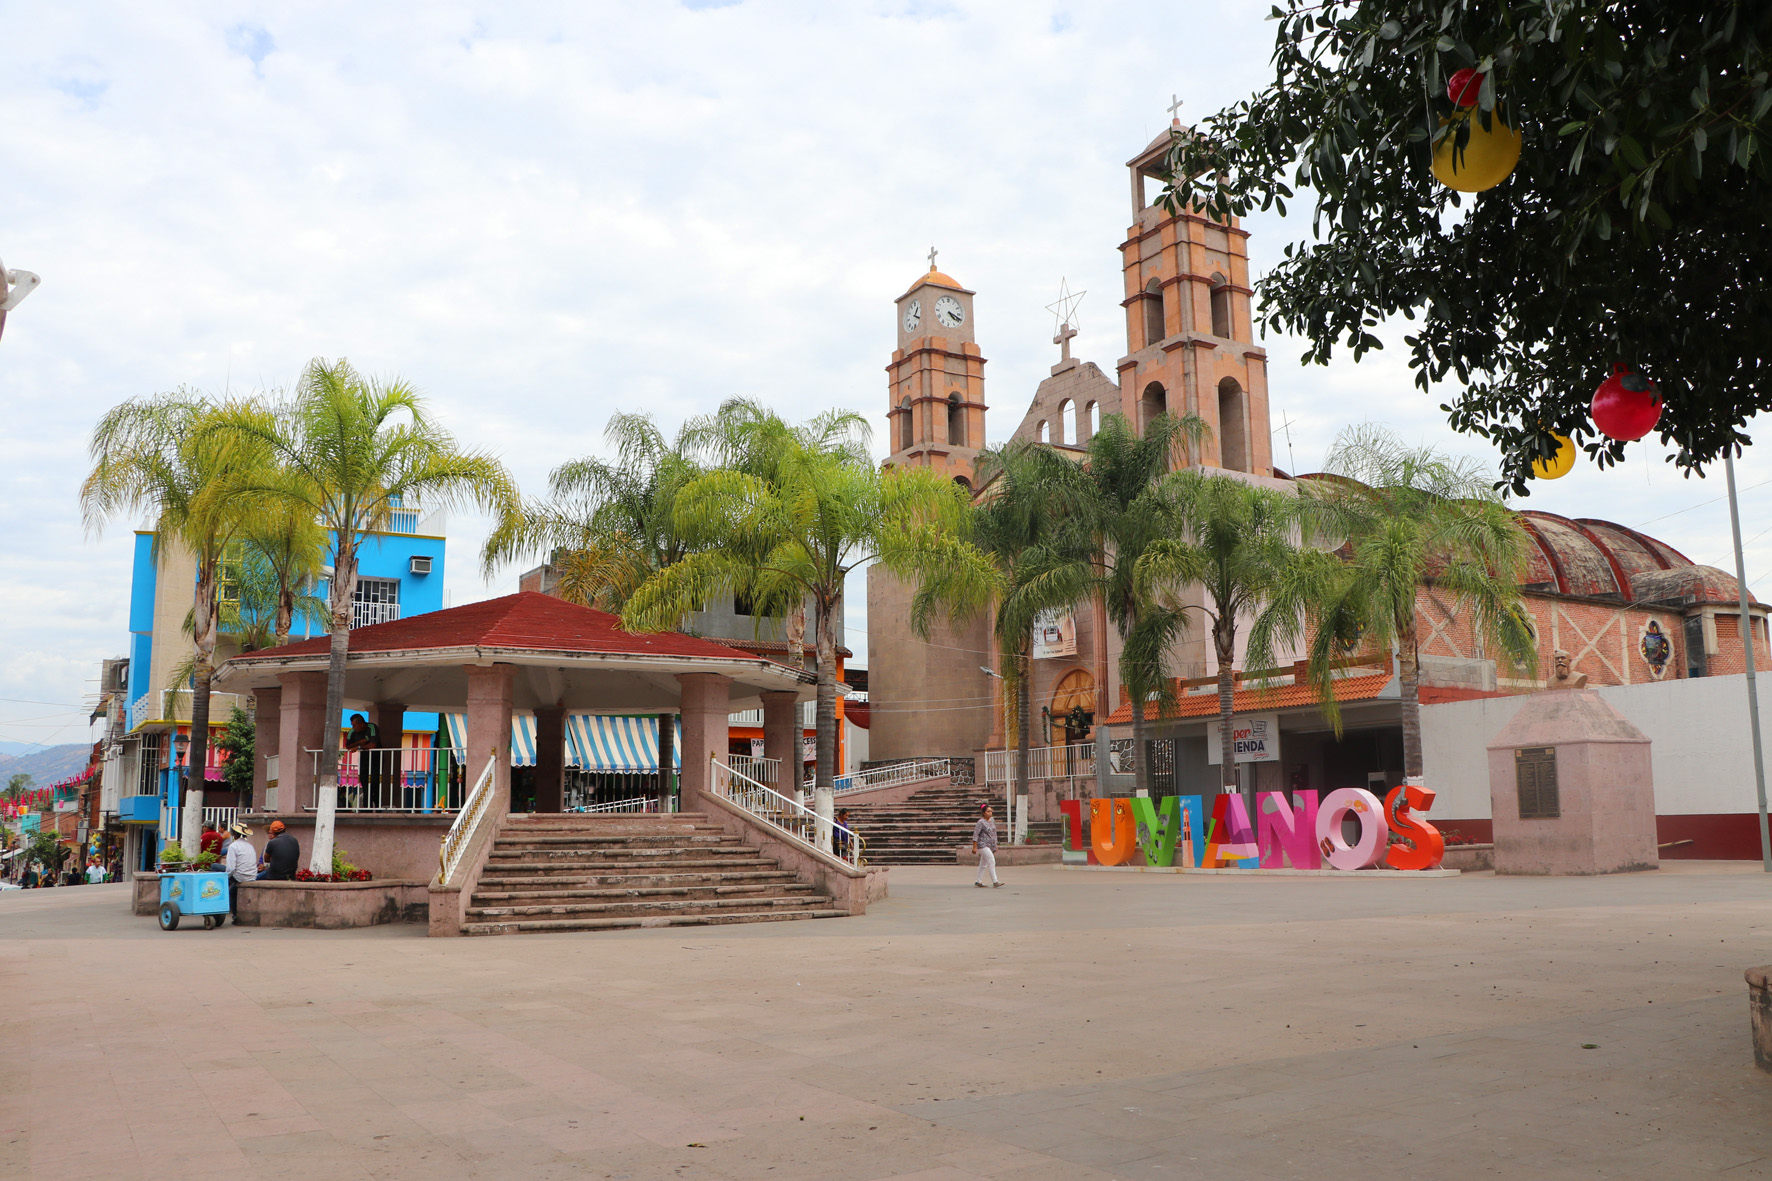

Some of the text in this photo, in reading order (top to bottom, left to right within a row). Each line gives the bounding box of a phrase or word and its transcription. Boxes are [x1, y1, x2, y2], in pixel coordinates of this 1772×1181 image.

[1233, 729, 1251, 741] per
[1234, 740, 1264, 752] IENDA
[1060, 785, 1445, 870] LUVIANOS
